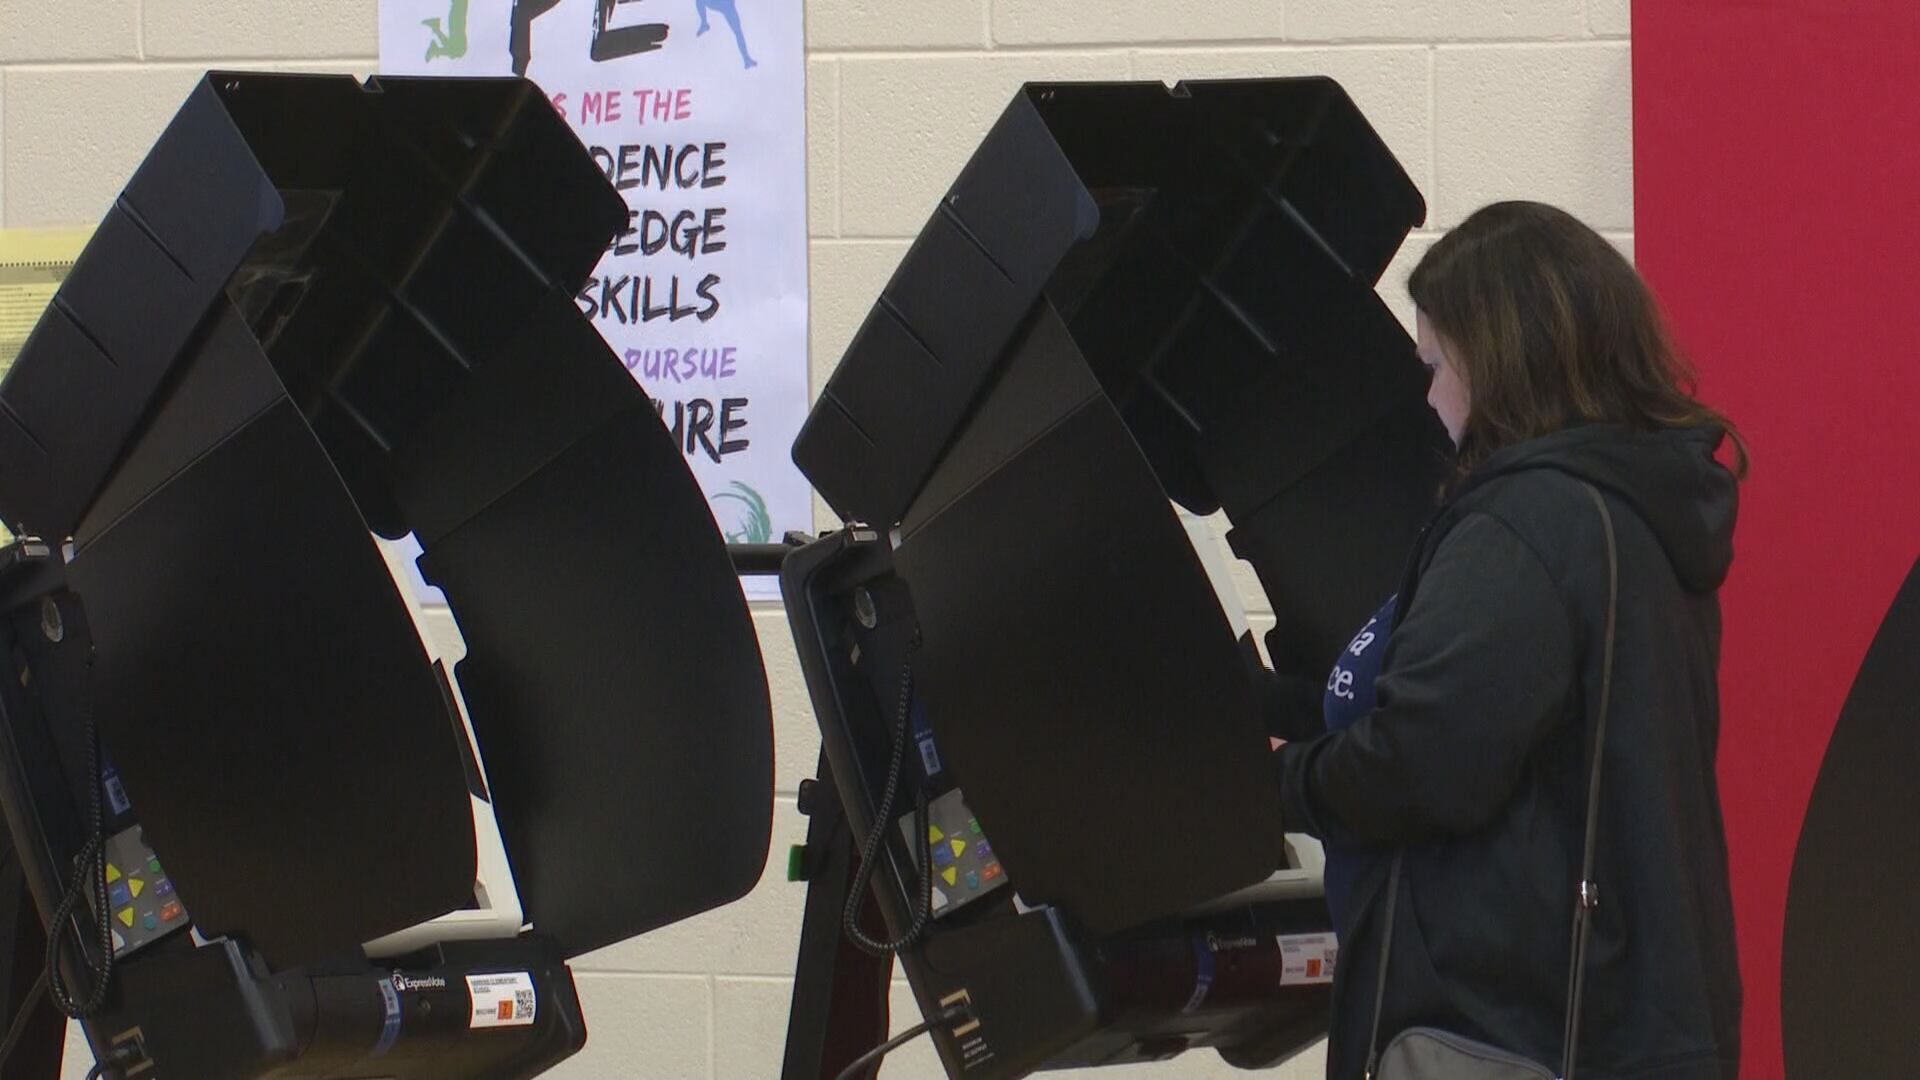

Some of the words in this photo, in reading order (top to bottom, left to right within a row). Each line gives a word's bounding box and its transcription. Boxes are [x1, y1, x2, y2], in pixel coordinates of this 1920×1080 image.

[581, 91, 622, 125] ME
[633, 89, 693, 125] THE
[608, 208, 727, 259] EDGE
[576, 273, 721, 324] SKILLS
[624, 347, 737, 383] PURSUE
[650, 398, 749, 463] URE
